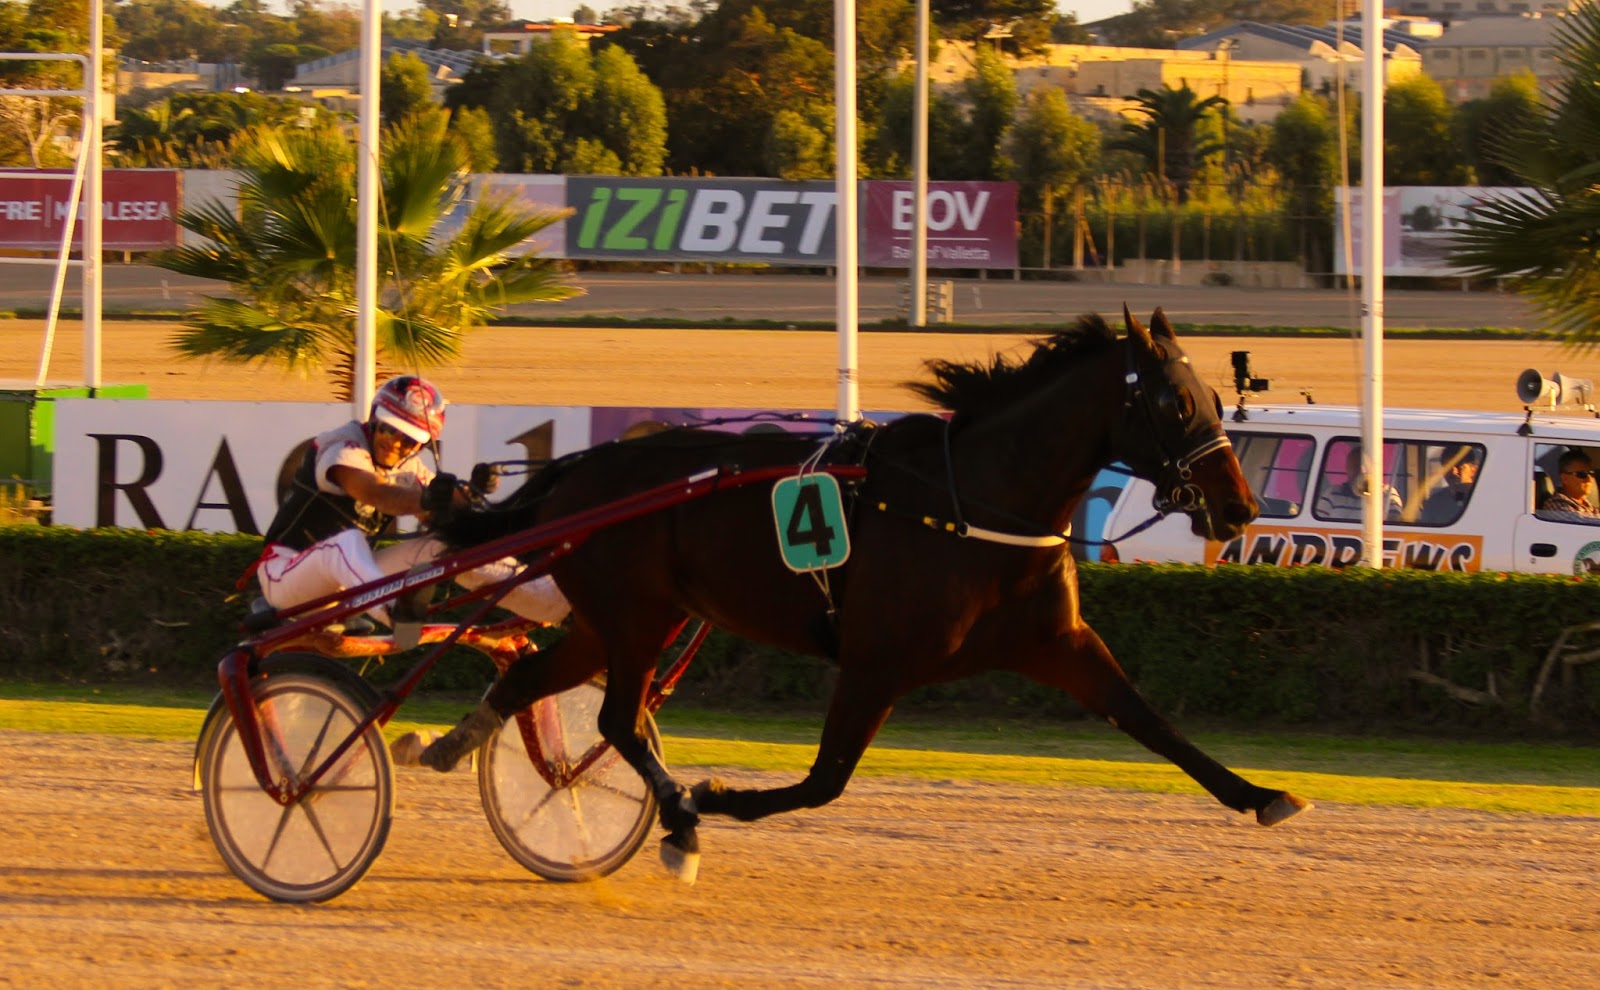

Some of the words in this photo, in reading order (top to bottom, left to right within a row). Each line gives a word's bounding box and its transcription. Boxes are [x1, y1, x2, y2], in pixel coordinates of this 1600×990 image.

[54, 201, 171, 220] MLESEA
[892, 190, 990, 231] BOV
[504, 419, 554, 480] 1
[787, 484, 835, 556] 4
